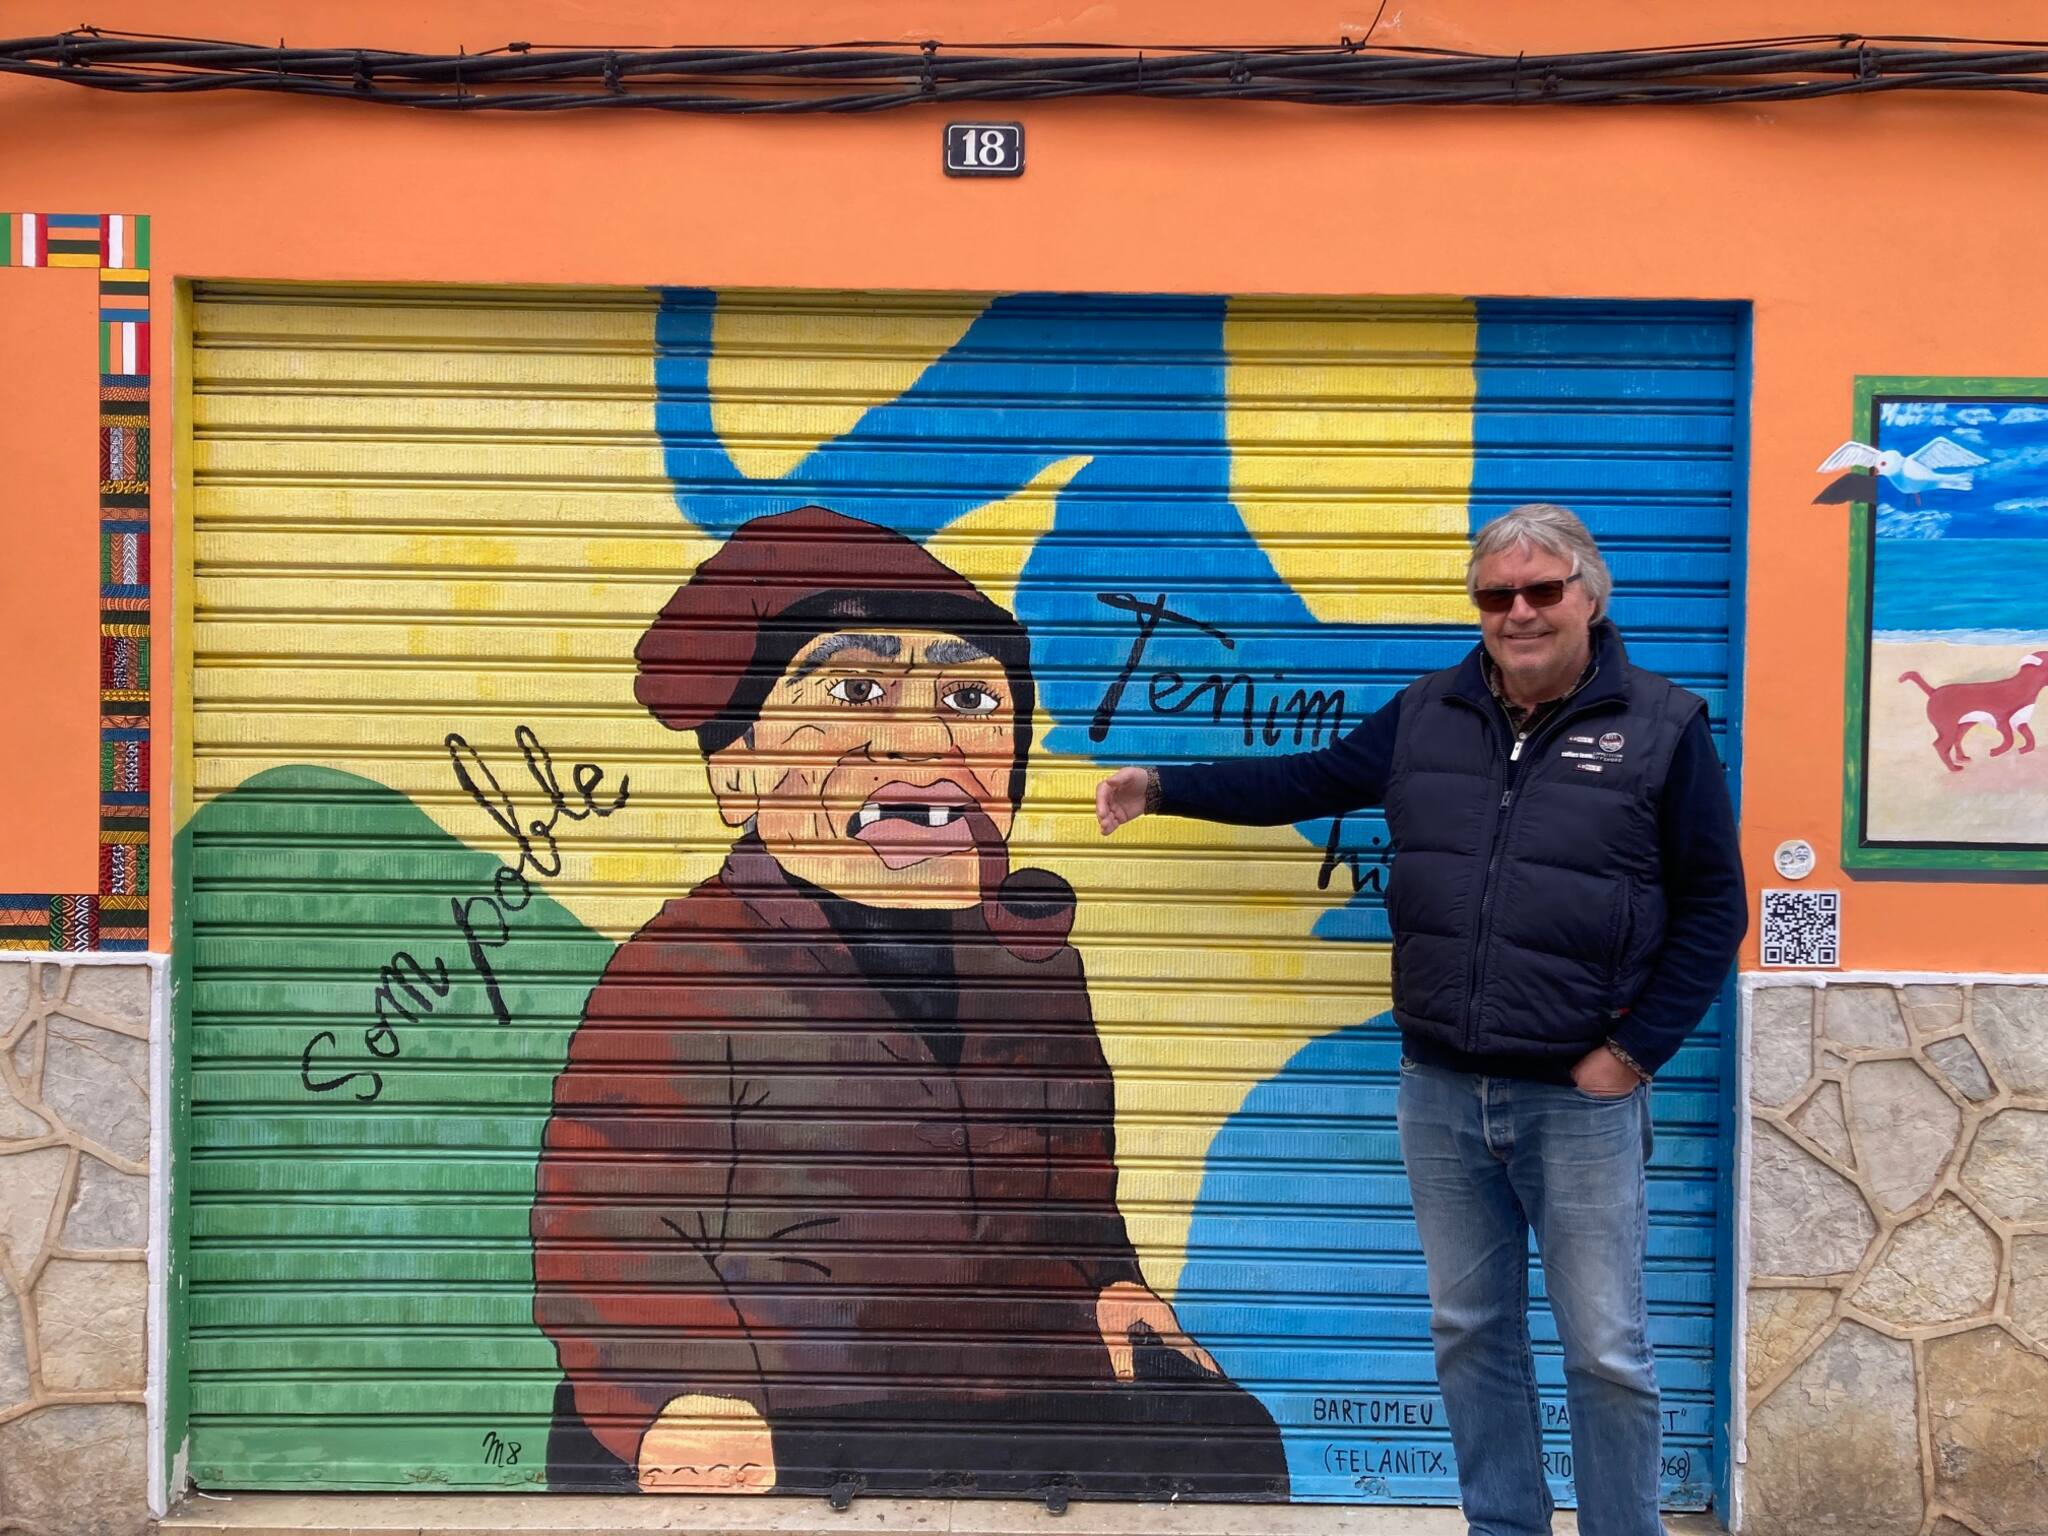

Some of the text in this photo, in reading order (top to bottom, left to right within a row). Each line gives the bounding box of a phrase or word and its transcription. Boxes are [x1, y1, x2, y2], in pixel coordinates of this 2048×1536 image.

[962, 129, 1005, 166] 18
[1089, 592, 1345, 747] Tenim
[301, 725, 630, 1101] Som poble
[1313, 1398, 1433, 1425] BARTOMEU
